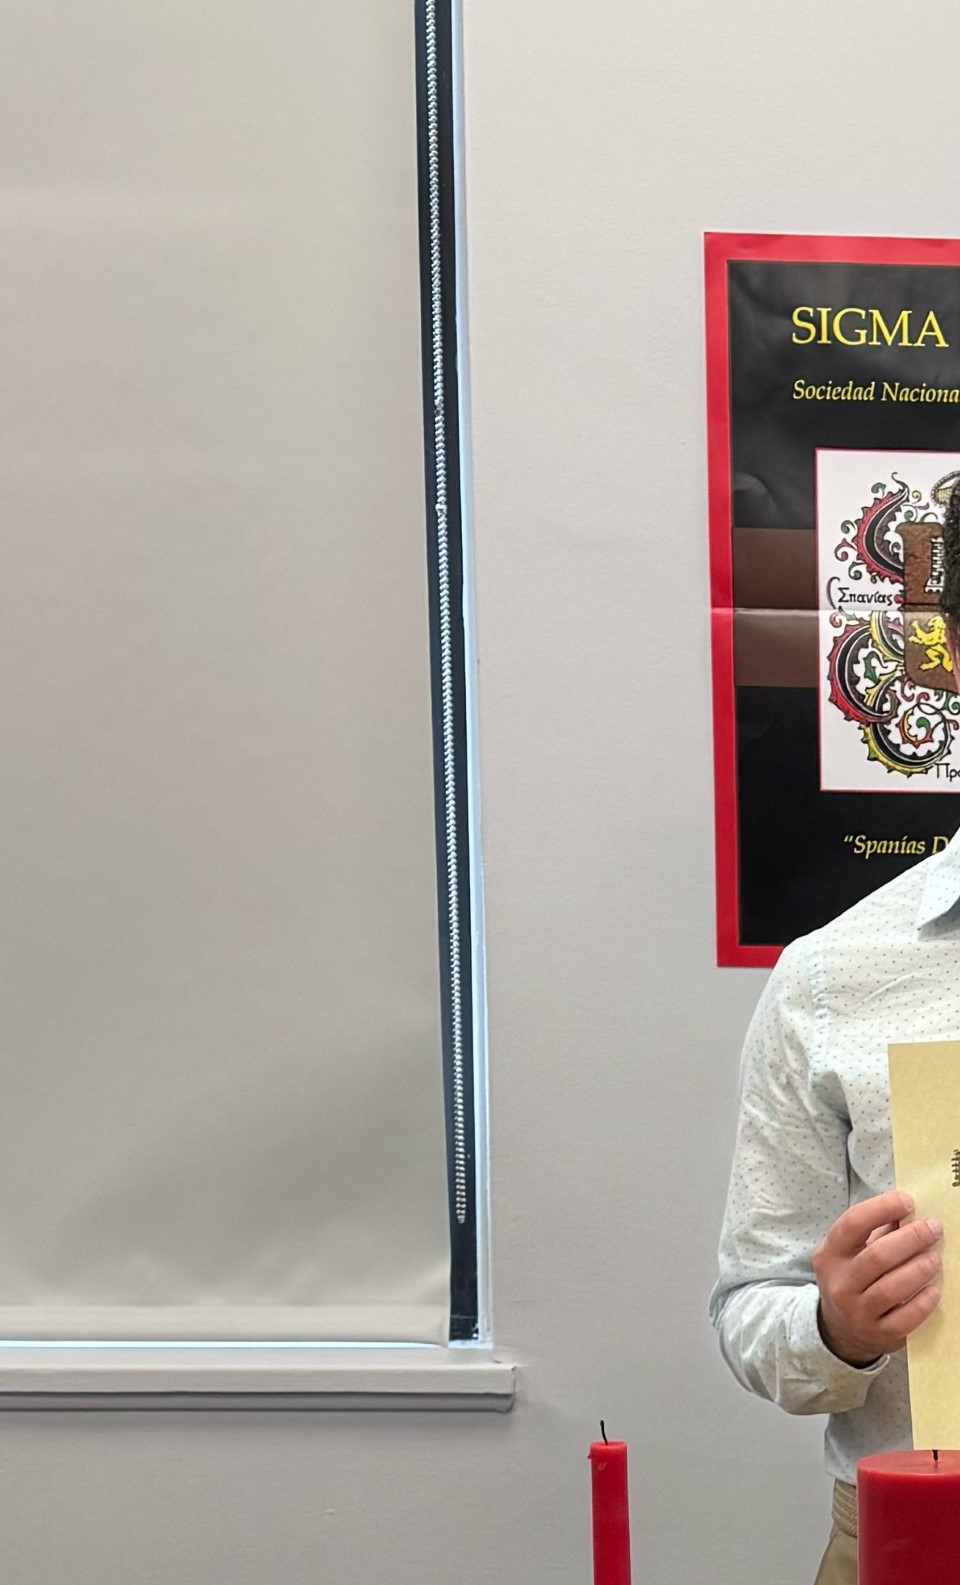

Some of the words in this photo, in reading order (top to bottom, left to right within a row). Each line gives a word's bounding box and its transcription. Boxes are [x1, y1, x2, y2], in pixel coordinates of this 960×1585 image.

[791, 305, 949, 348] SIGMA
[793, 380, 875, 402] Sociedad
[838, 587, 893, 605] Σπανίας
